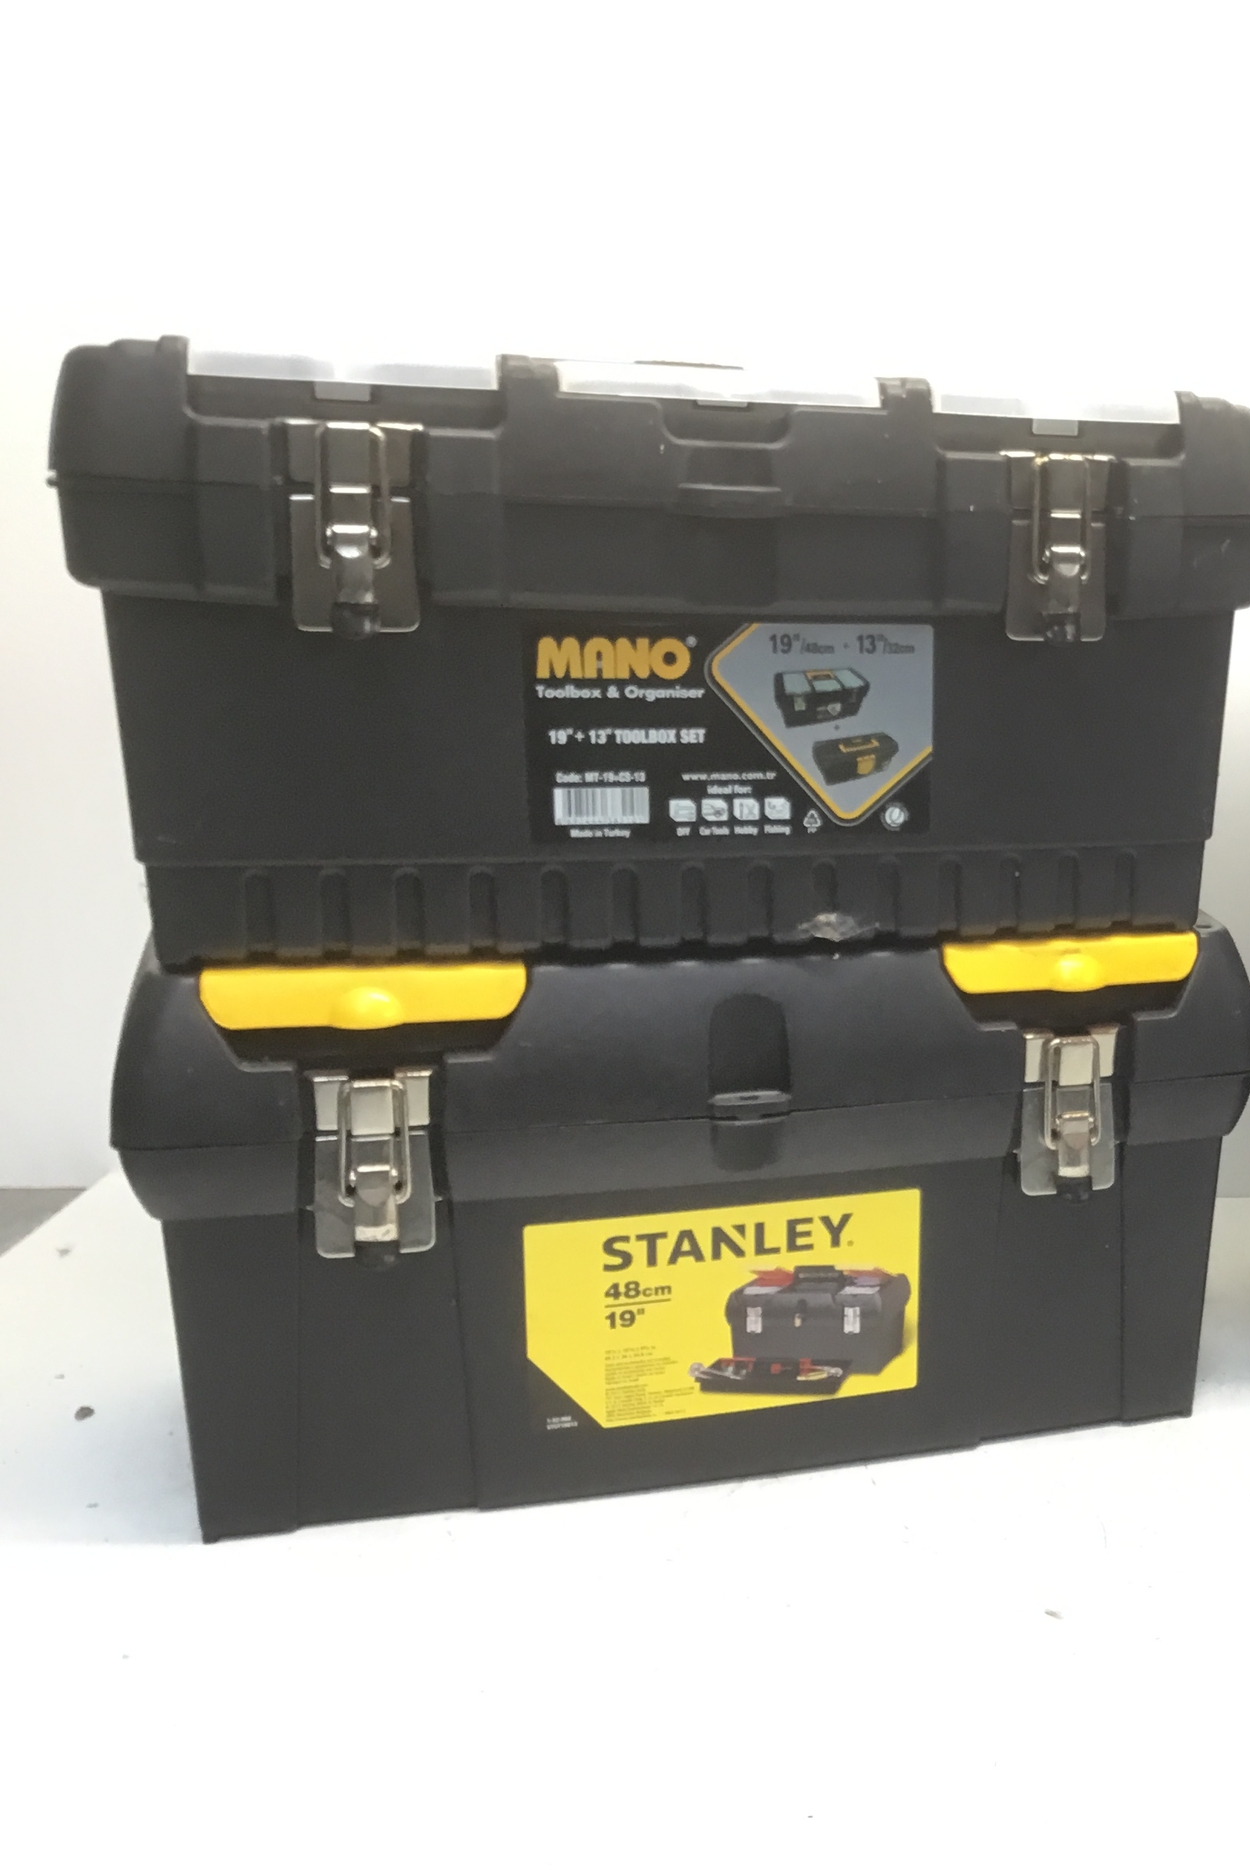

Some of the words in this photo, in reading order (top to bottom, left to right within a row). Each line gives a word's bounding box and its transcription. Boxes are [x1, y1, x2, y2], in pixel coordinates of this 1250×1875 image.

[536, 636, 690, 680] MANO
[535, 684, 601, 699] Toolbox
[606, 685, 620, 699] &
[624, 685, 704, 702] Organiser
[614, 728, 677, 744] TOOLBOX
[679, 728, 706, 744] SET
[681, 771, 777, 783] www.mano.com.tr
[707, 784, 733, 795] ideal
[602, 1212, 853, 1273] STANLEY
[604, 1280, 672, 1301] 48cm
[604, 1308, 645, 1330] 19"
